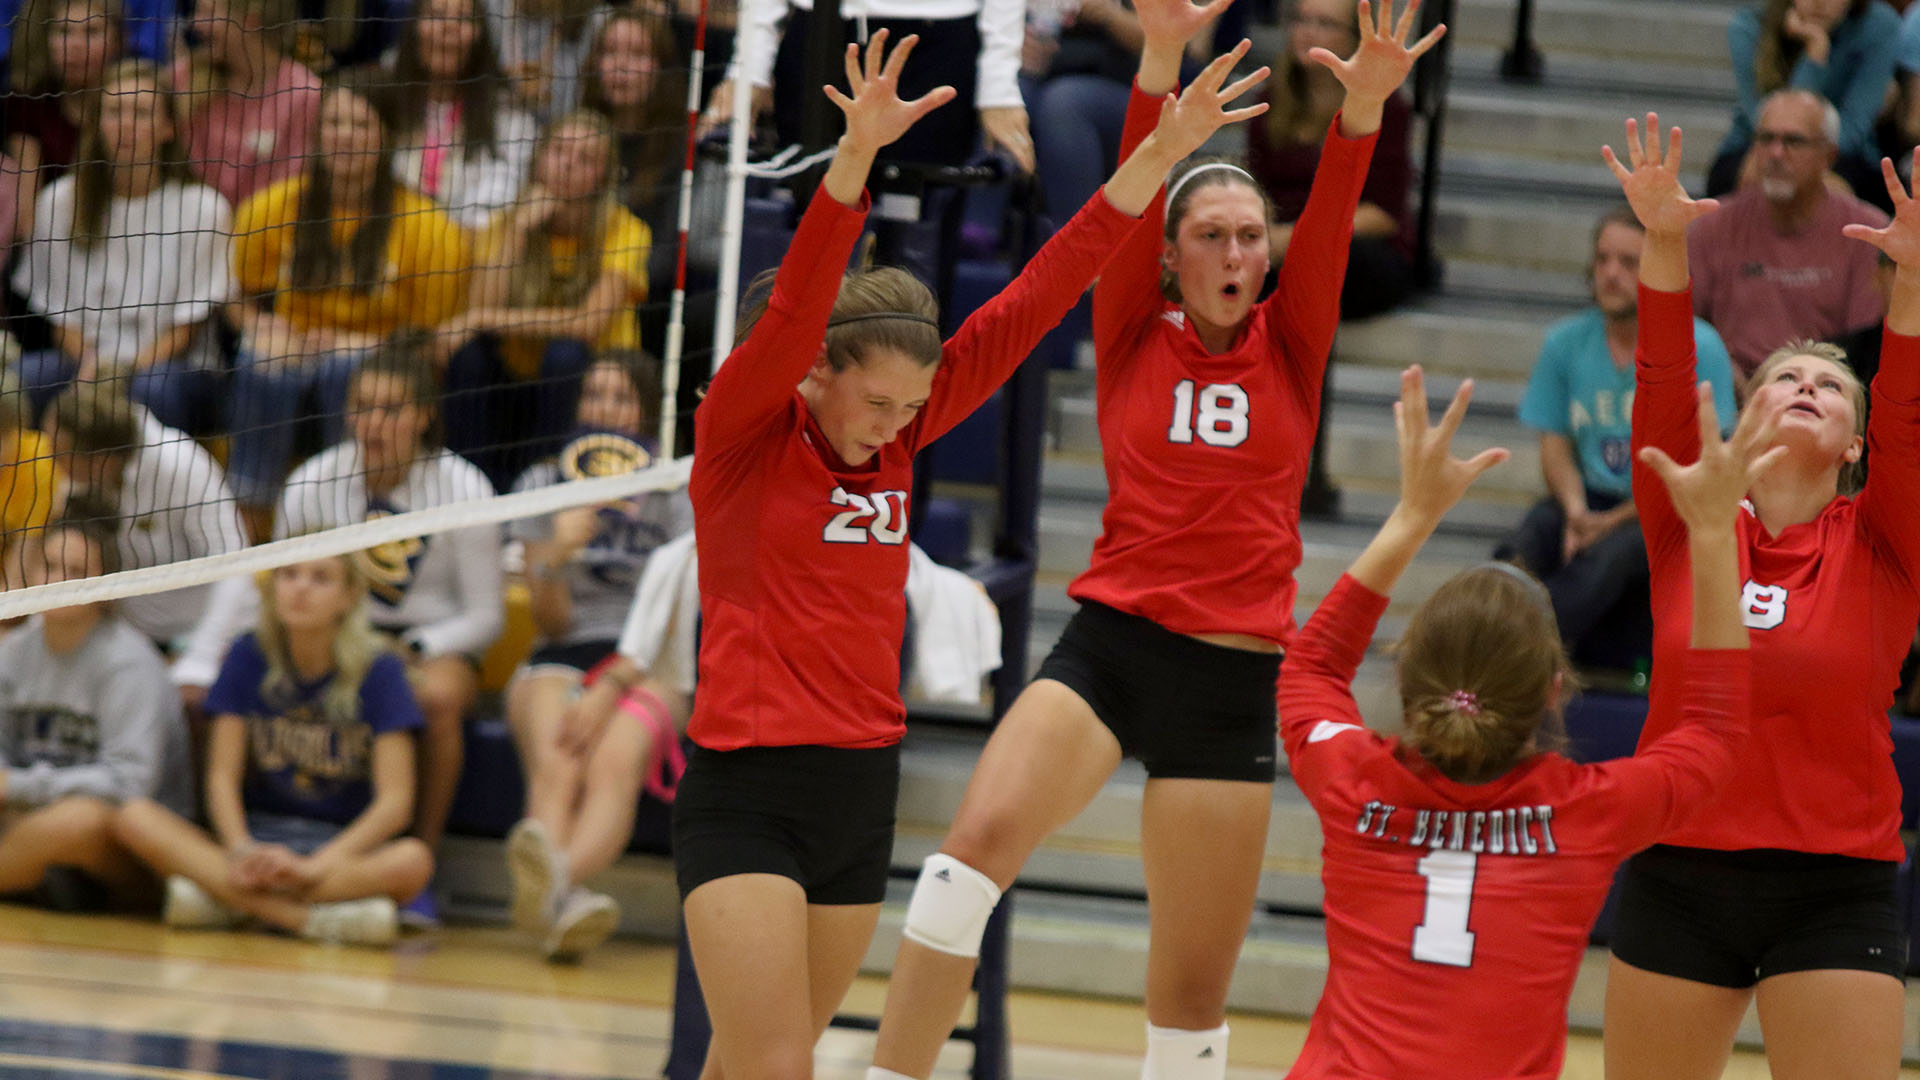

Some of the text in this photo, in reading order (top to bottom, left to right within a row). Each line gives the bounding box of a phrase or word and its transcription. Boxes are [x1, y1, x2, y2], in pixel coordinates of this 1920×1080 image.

[1168, 378, 1250, 448] 18
[822, 486, 908, 545] 20
[1741, 577, 1789, 630] 8
[1356, 800, 1557, 855] ST. BENEDICT
[1411, 848, 1478, 968] 1
